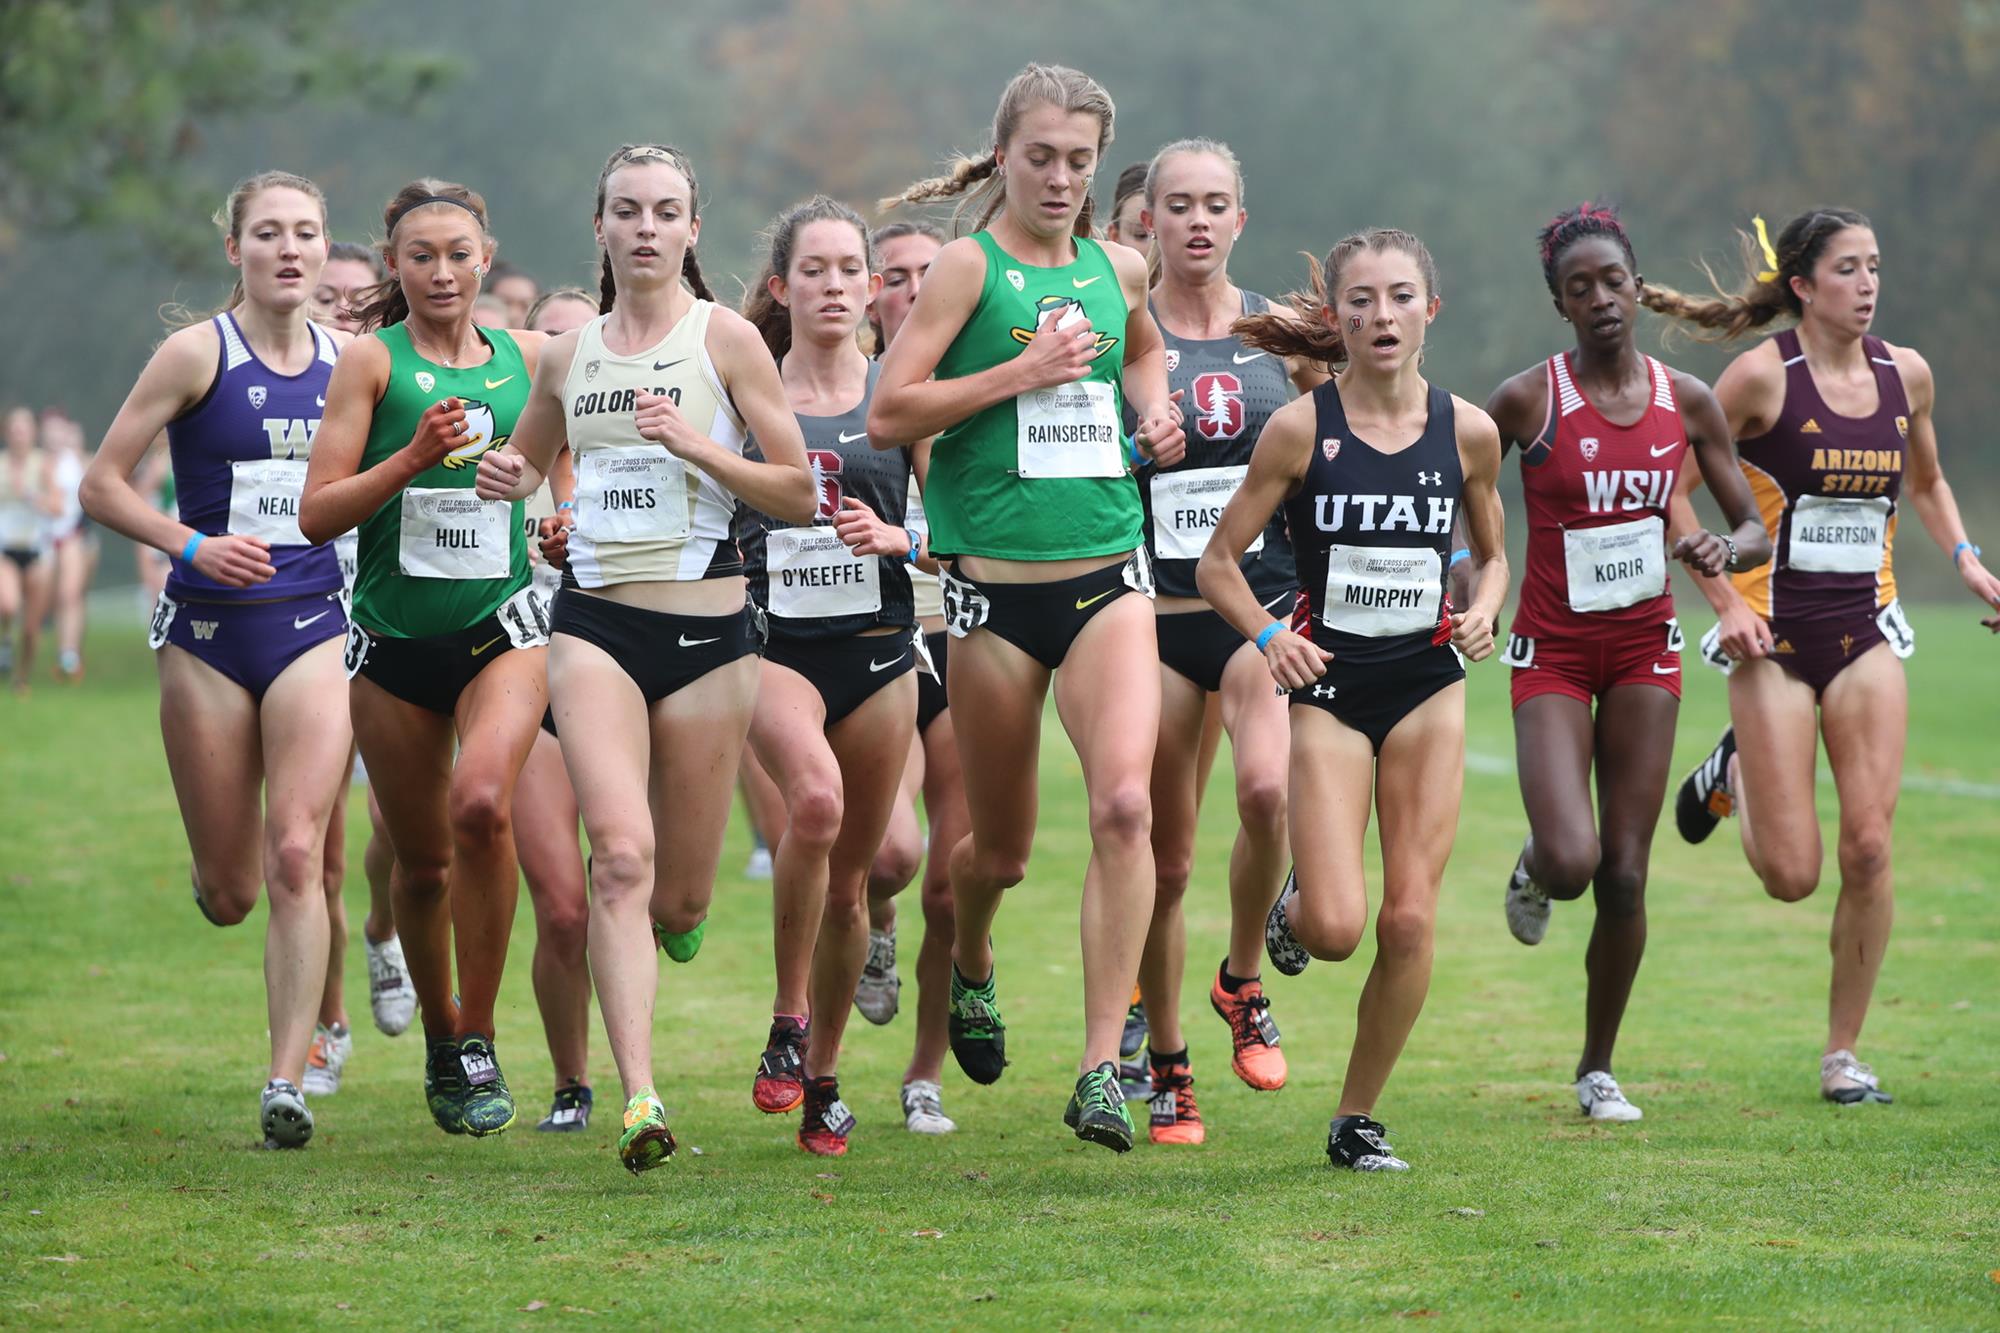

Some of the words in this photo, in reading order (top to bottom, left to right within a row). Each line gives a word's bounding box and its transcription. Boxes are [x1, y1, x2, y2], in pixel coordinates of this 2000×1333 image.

[574, 387, 681, 417] COLORO
[1028, 424, 1113, 444] RAINSBERGER
[609, 465, 650, 474] CHAMPIONSHIPS
[641, 457, 667, 465] COUNTRY
[1811, 448, 1901, 472] ARIZONA
[1582, 470, 1674, 513] WSU
[1822, 474, 1890, 492] STATE
[258, 497, 297, 516] NEAL
[454, 499, 472, 507] CROSS
[603, 488, 656, 511] JONES
[1175, 507, 1225, 529] FRAS
[1315, 495, 1454, 533] UTAH
[436, 529, 480, 549] HULL
[1800, 525, 1876, 544] ALBERTSON
[782, 563, 865, 587] O'KEEFFE
[1595, 558, 1644, 583] KORIR
[1345, 584, 1424, 609] MURPHY
[190, 619, 219, 640] W
